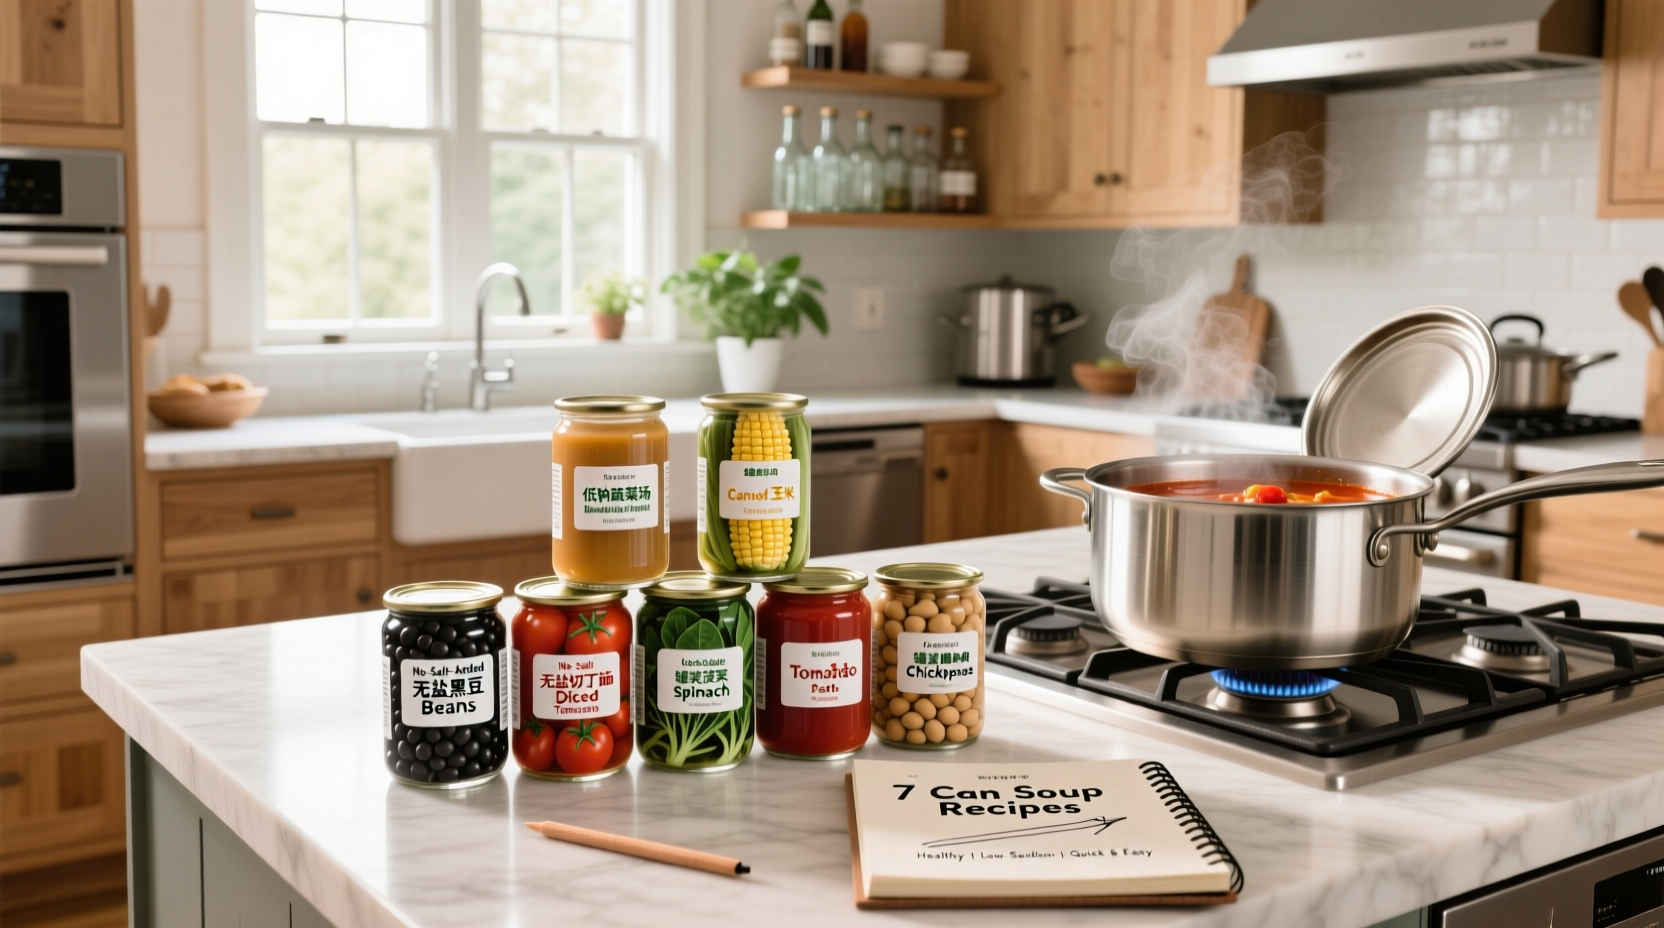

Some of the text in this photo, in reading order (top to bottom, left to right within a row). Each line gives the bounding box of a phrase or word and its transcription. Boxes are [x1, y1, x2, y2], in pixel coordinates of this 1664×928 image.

[673, 684, 730, 702] Spinach
[421, 700, 477, 716] Beans
[893, 784, 1103, 802] 7 Can Soup
[939, 801, 1082, 819] Recipes
